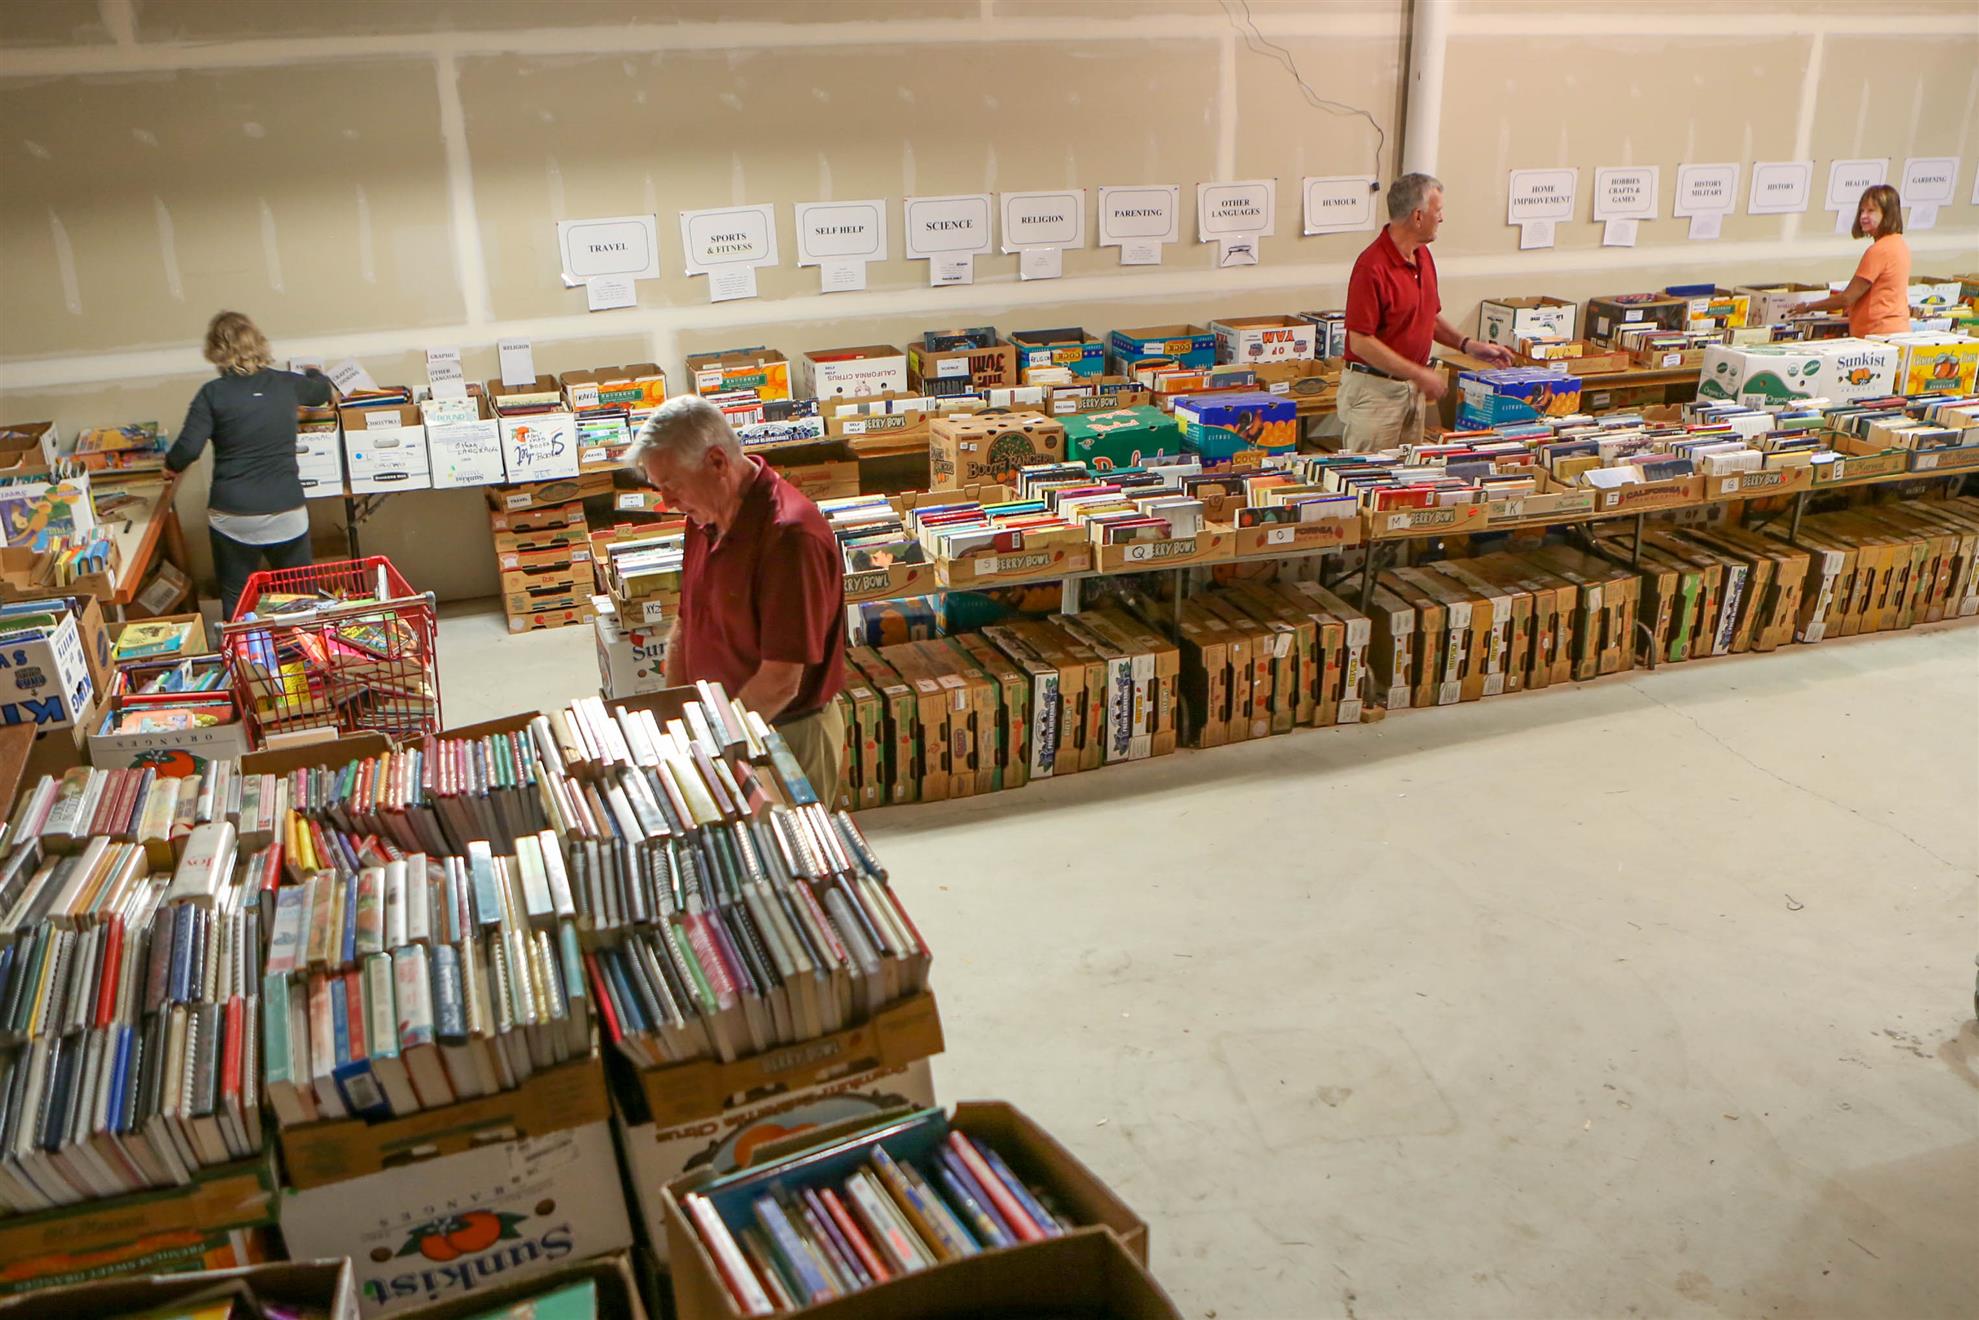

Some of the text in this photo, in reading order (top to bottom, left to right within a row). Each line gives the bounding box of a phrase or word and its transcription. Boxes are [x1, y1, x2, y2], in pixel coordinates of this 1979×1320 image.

[1611, 178, 1640, 186] HOBBIES
[1694, 180, 1722, 188] HISTORY
[1845, 180, 1870, 188] HEALTH
[1912, 176, 1947, 184] GARDENING
[1531, 185, 1555, 193] HOME
[1609, 187, 1633, 195] CRAFTS
[1691, 189, 1723, 197] MILITARY
[1767, 183, 1794, 191] HISTORY
[1221, 198, 1250, 208] OTHER
[1322, 197, 1357, 208] HUMOUR
[1514, 195, 1571, 206] IMPROVEMENT
[1612, 196, 1636, 204] GAMES
[1114, 208, 1162, 218] PARENTING
[1211, 207, 1260, 219] LANGUAGES
[926, 218, 973, 232] SCIENCE
[1020, 214, 1064, 225] RELIGION
[815, 225, 865, 236] SELF HELP
[710, 232, 747, 243] SPORTS
[588, 242, 628, 254] TRAVEL
[707, 243, 753, 255] & FITNESS
[1262, 330, 1295, 344] YAM
[503, 343, 530, 351] RELIGION
[1272, 347, 1285, 355] OF
[1836, 352, 1885, 370] Sunkist
[430, 368, 451, 376] OTHER
[827, 369, 897, 382] CALIFORNIA CITRUS
[1078, 396, 1118, 408] BERRY BOWL
[864, 417, 905, 430] BERRY BOWL
[967, 461, 1006, 479] BOOTH
[1834, 464, 1842, 479] E
[1743, 474, 1765, 488] BERRY
[1626, 486, 1681, 499] CALIFORNIA
[1509, 501, 1517, 514] K
[1410, 510, 1455, 525] BERRY BOWL
[1132, 545, 1145, 560] Q
[1170, 540, 1196, 555] BOWL
[996, 553, 1050, 571] BERRY BOWL
[863, 573, 889, 589] BOWL
[646, 603, 662, 615] XYZ
[117, 733, 213, 747] ORANGES
[656, 1122, 718, 1143] Citrus
[366, 1223, 573, 1305] Sunkist
